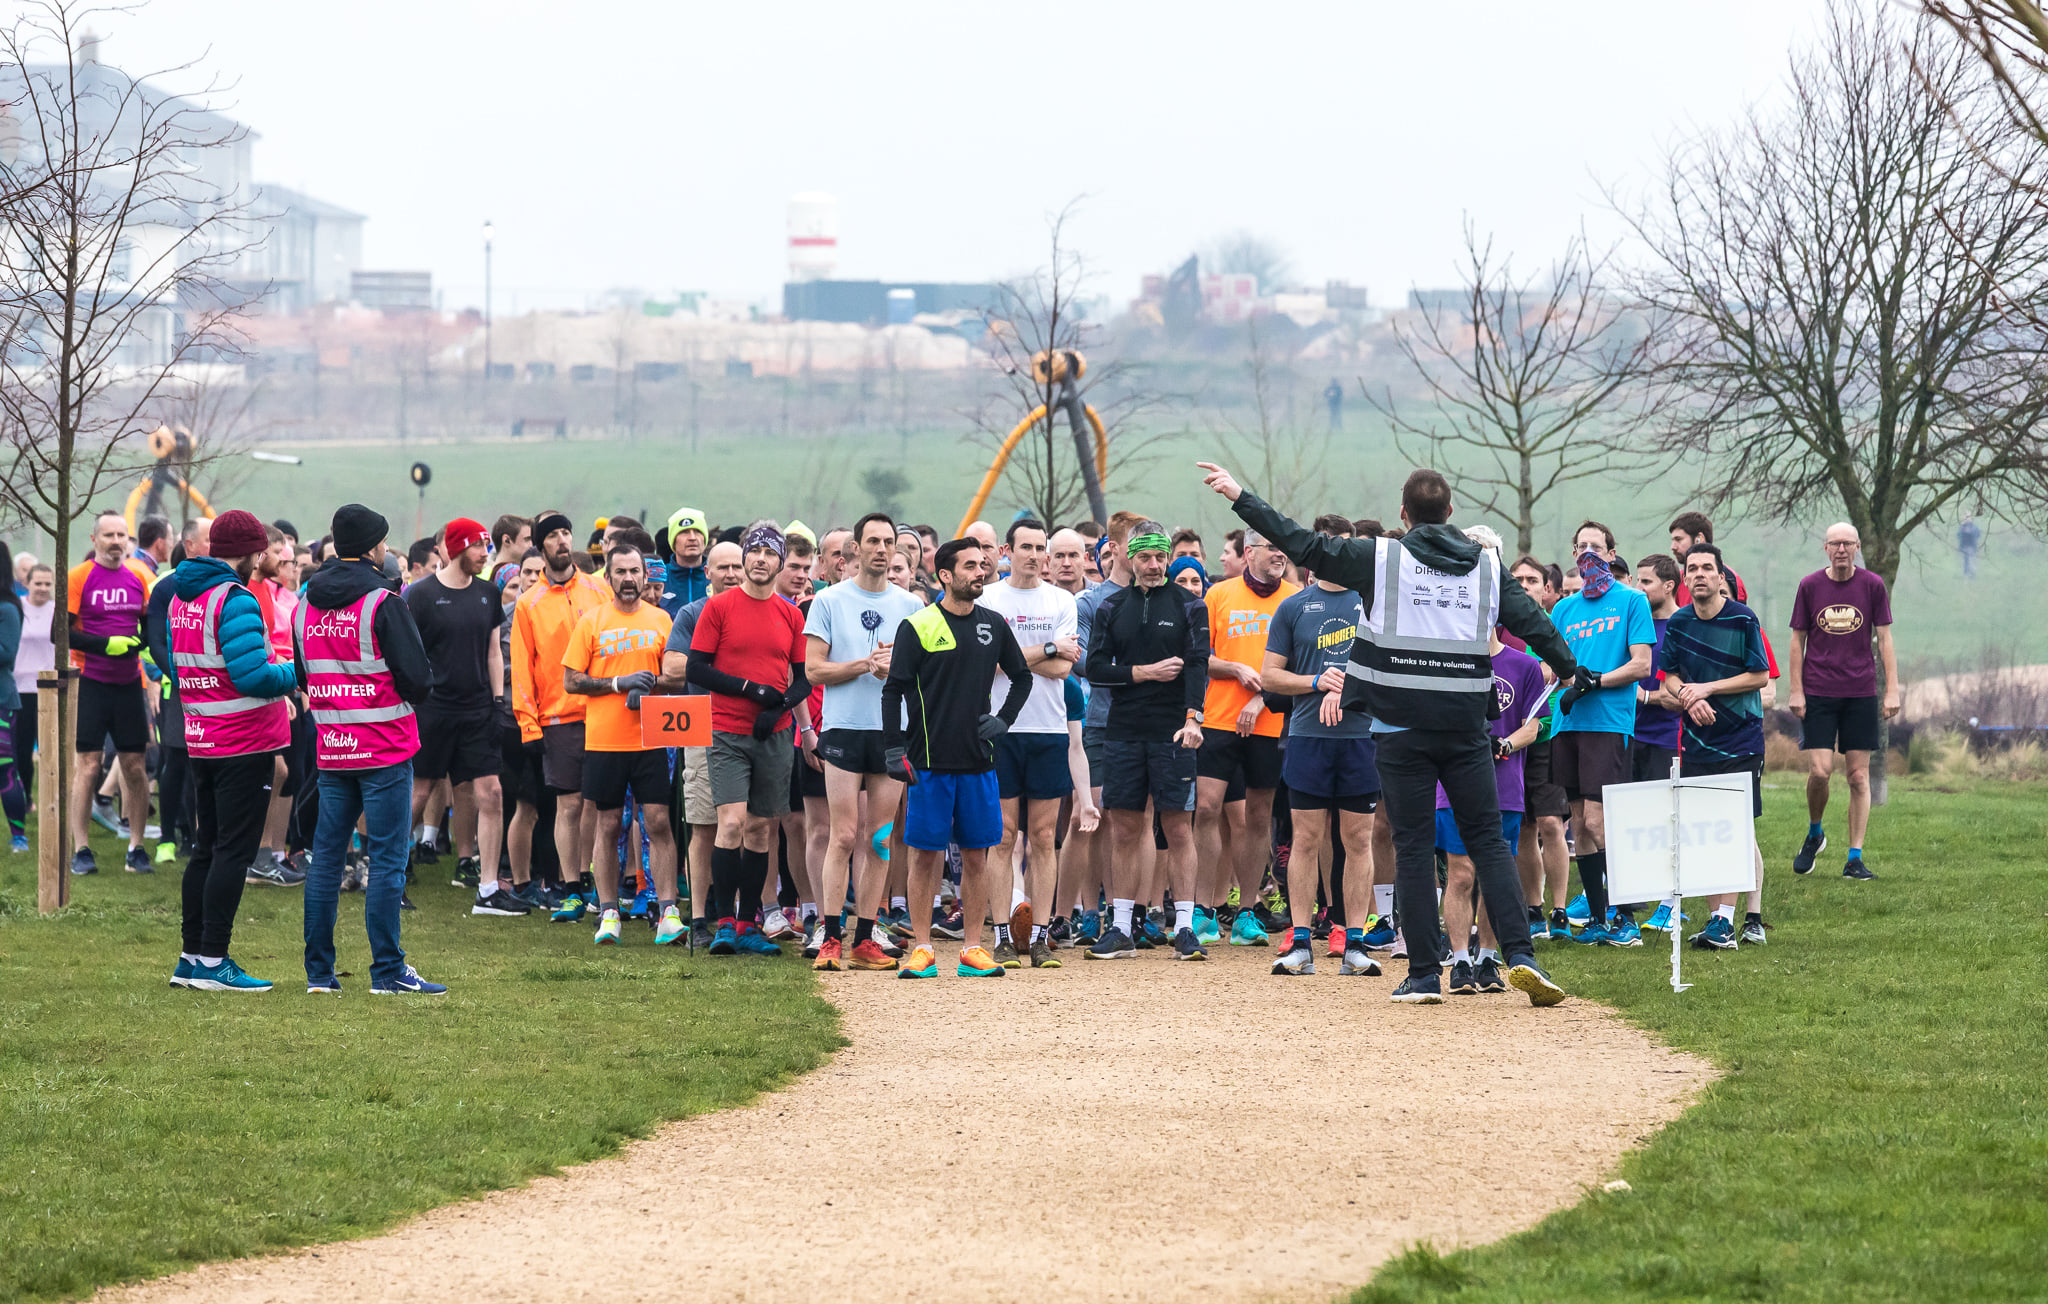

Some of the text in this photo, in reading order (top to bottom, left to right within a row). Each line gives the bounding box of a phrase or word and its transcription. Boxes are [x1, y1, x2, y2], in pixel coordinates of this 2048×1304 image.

[91, 587, 128, 606] run
[306, 614, 357, 641] parkrun
[976, 623, 993, 646] 5
[1017, 623, 1053, 631] FINISHER
[1390, 656, 1417, 665] Thanks
[307, 683, 376, 698] VOLUNTEER
[662, 711, 691, 732] 20
[323, 729, 359, 752] Vitality
